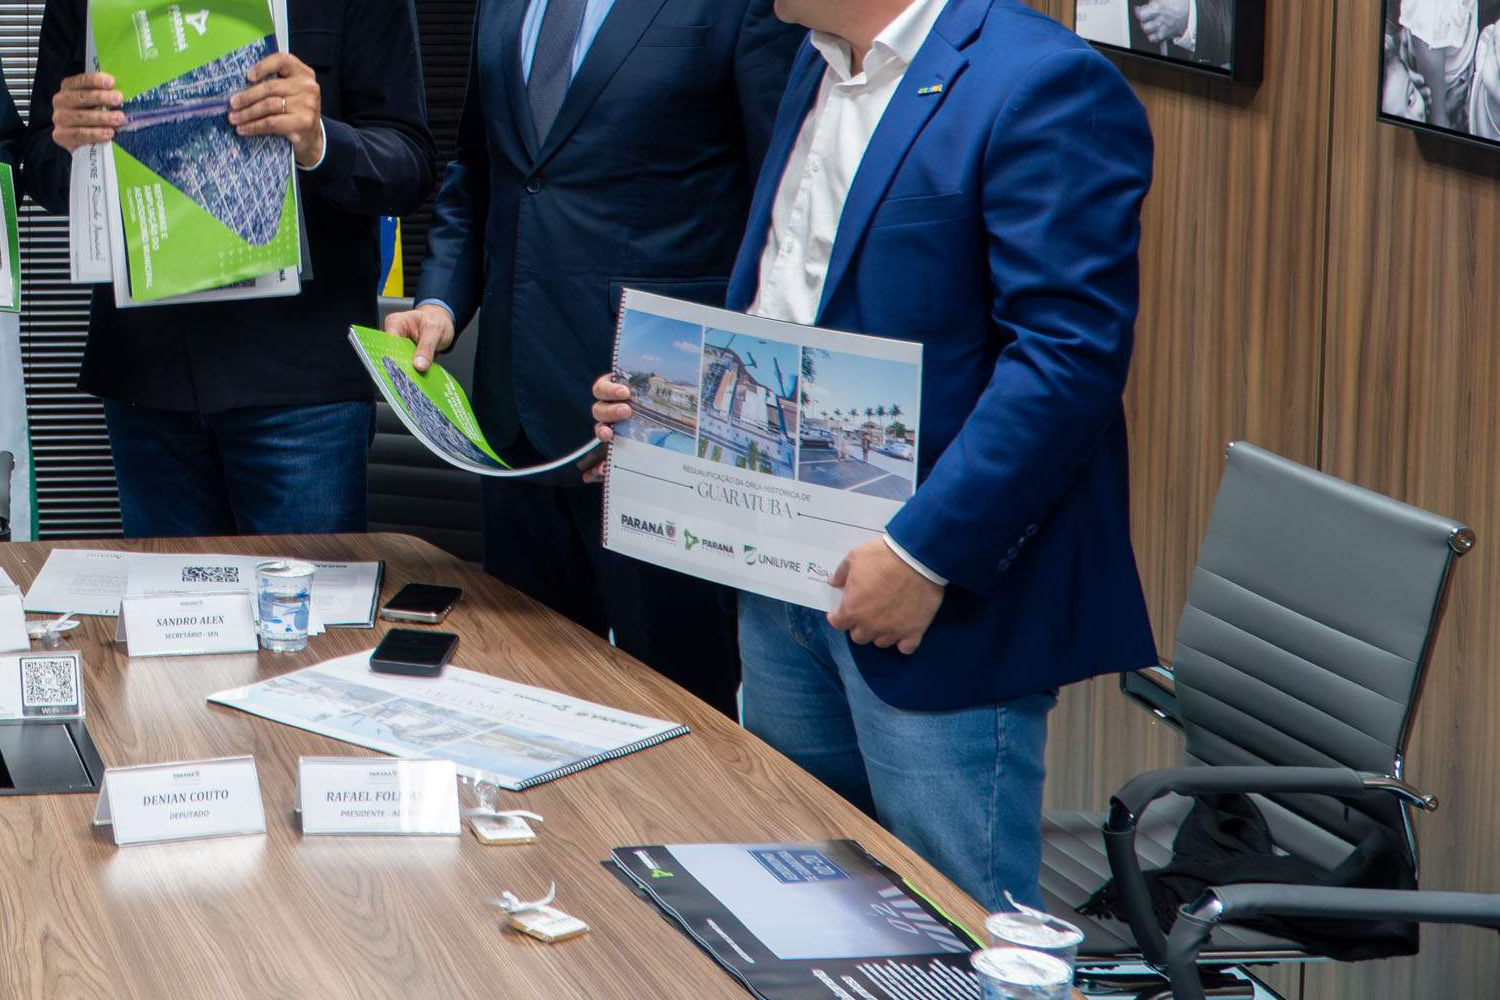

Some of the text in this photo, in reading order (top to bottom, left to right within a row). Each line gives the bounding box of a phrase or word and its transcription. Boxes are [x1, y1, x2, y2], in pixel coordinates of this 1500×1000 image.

[697, 481, 793, 520] GUARATUBA
[621, 513, 664, 536] PARANÁ
[758, 553, 801, 573] UNILIVRE
[156, 615, 225, 627] SANDRO ALEX
[164, 631, 203, 640] SECRETÁRIO
[143, 789, 229, 806] DENIAN COUTO
[326, 791, 372, 802] RAFAEL
[169, 809, 210, 820] DEPUTADO
[340, 810, 385, 818] PRESIDENTE
